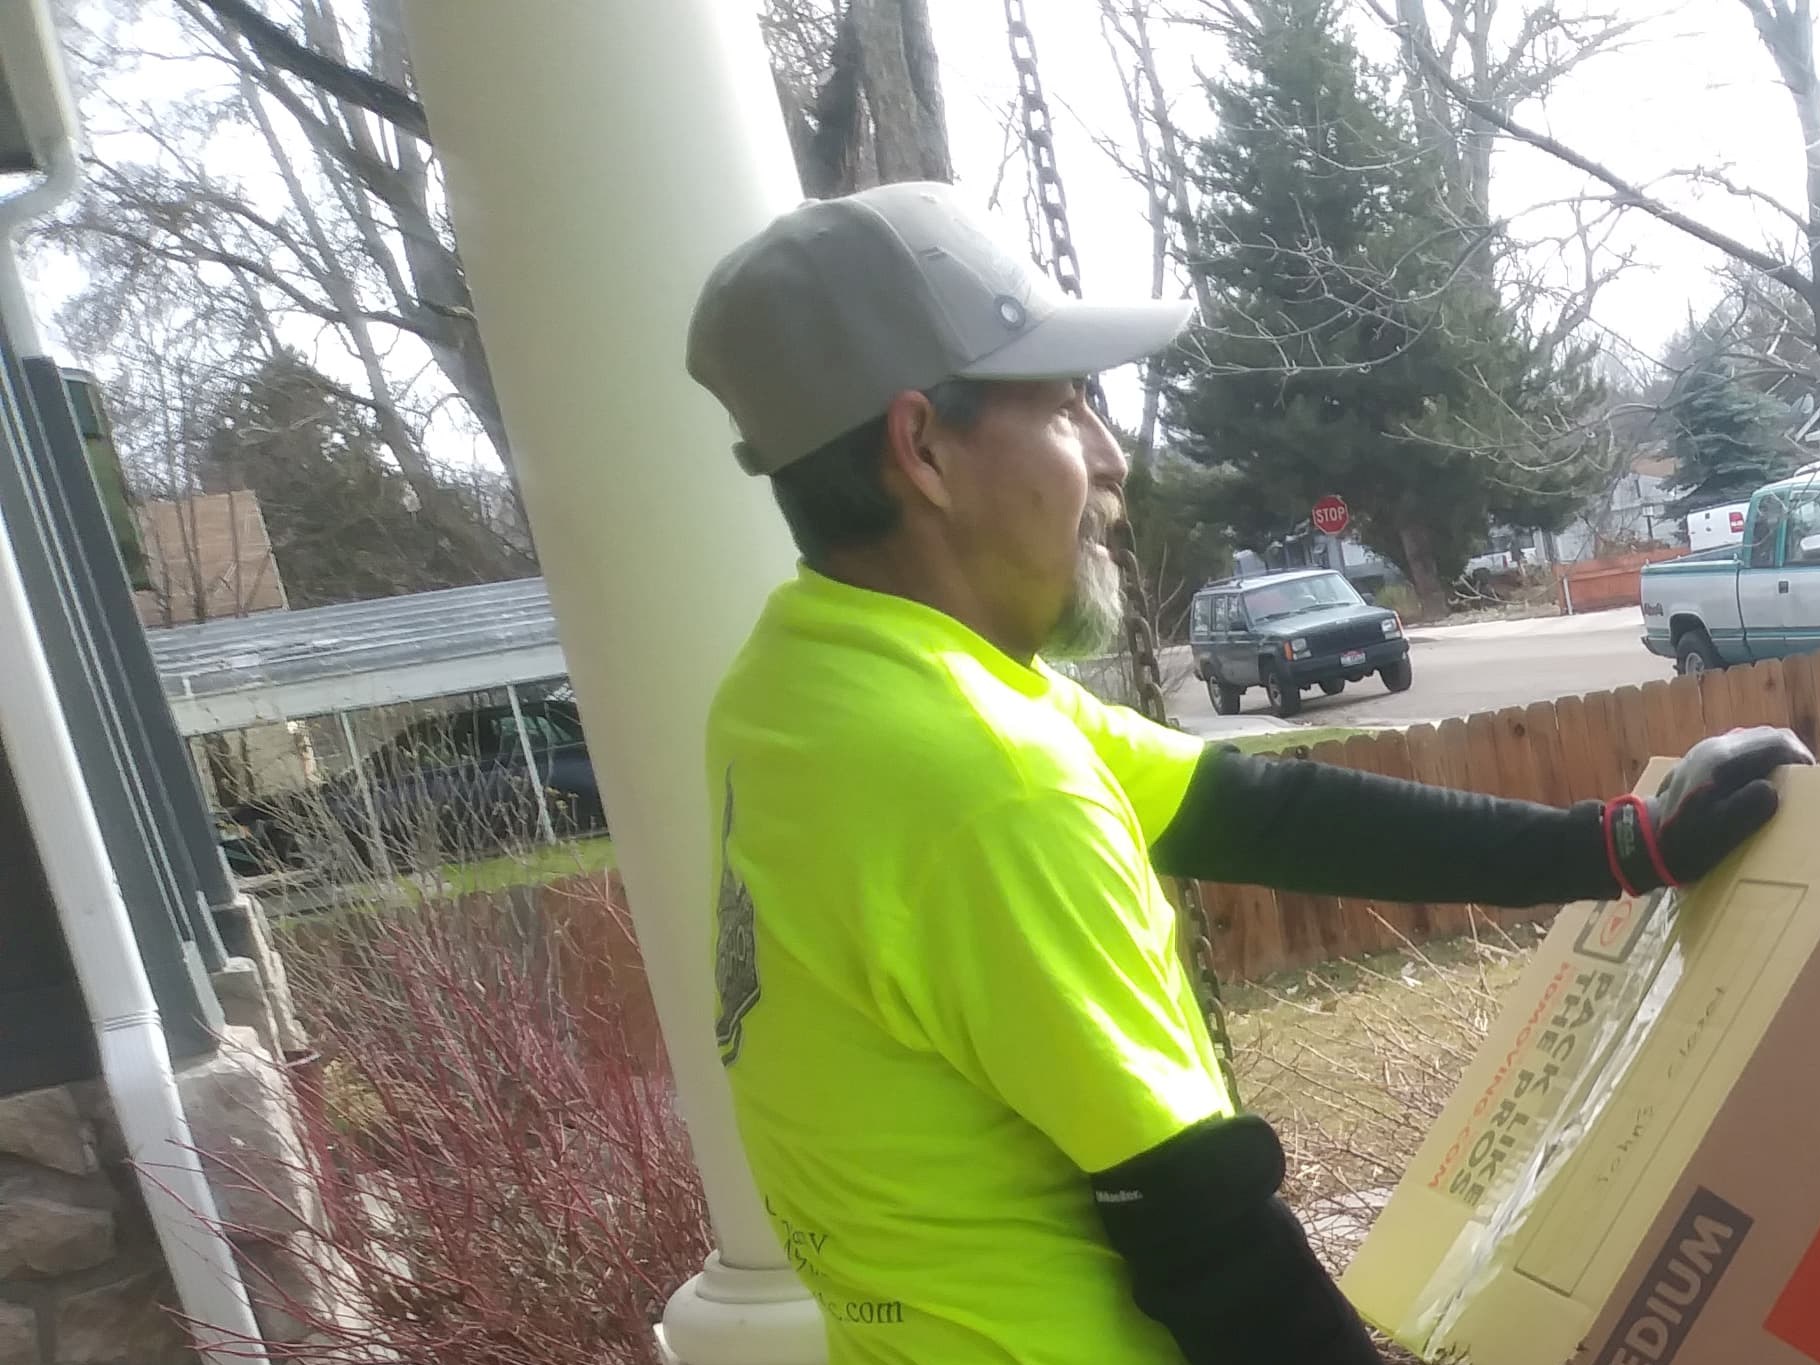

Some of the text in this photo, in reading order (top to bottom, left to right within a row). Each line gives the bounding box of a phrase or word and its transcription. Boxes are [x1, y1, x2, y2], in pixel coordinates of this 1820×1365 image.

[1315, 506, 1345, 524] STOP
[1449, 970, 1597, 1194] THE PROS
[1464, 972, 1615, 1207] PACK LIKE
